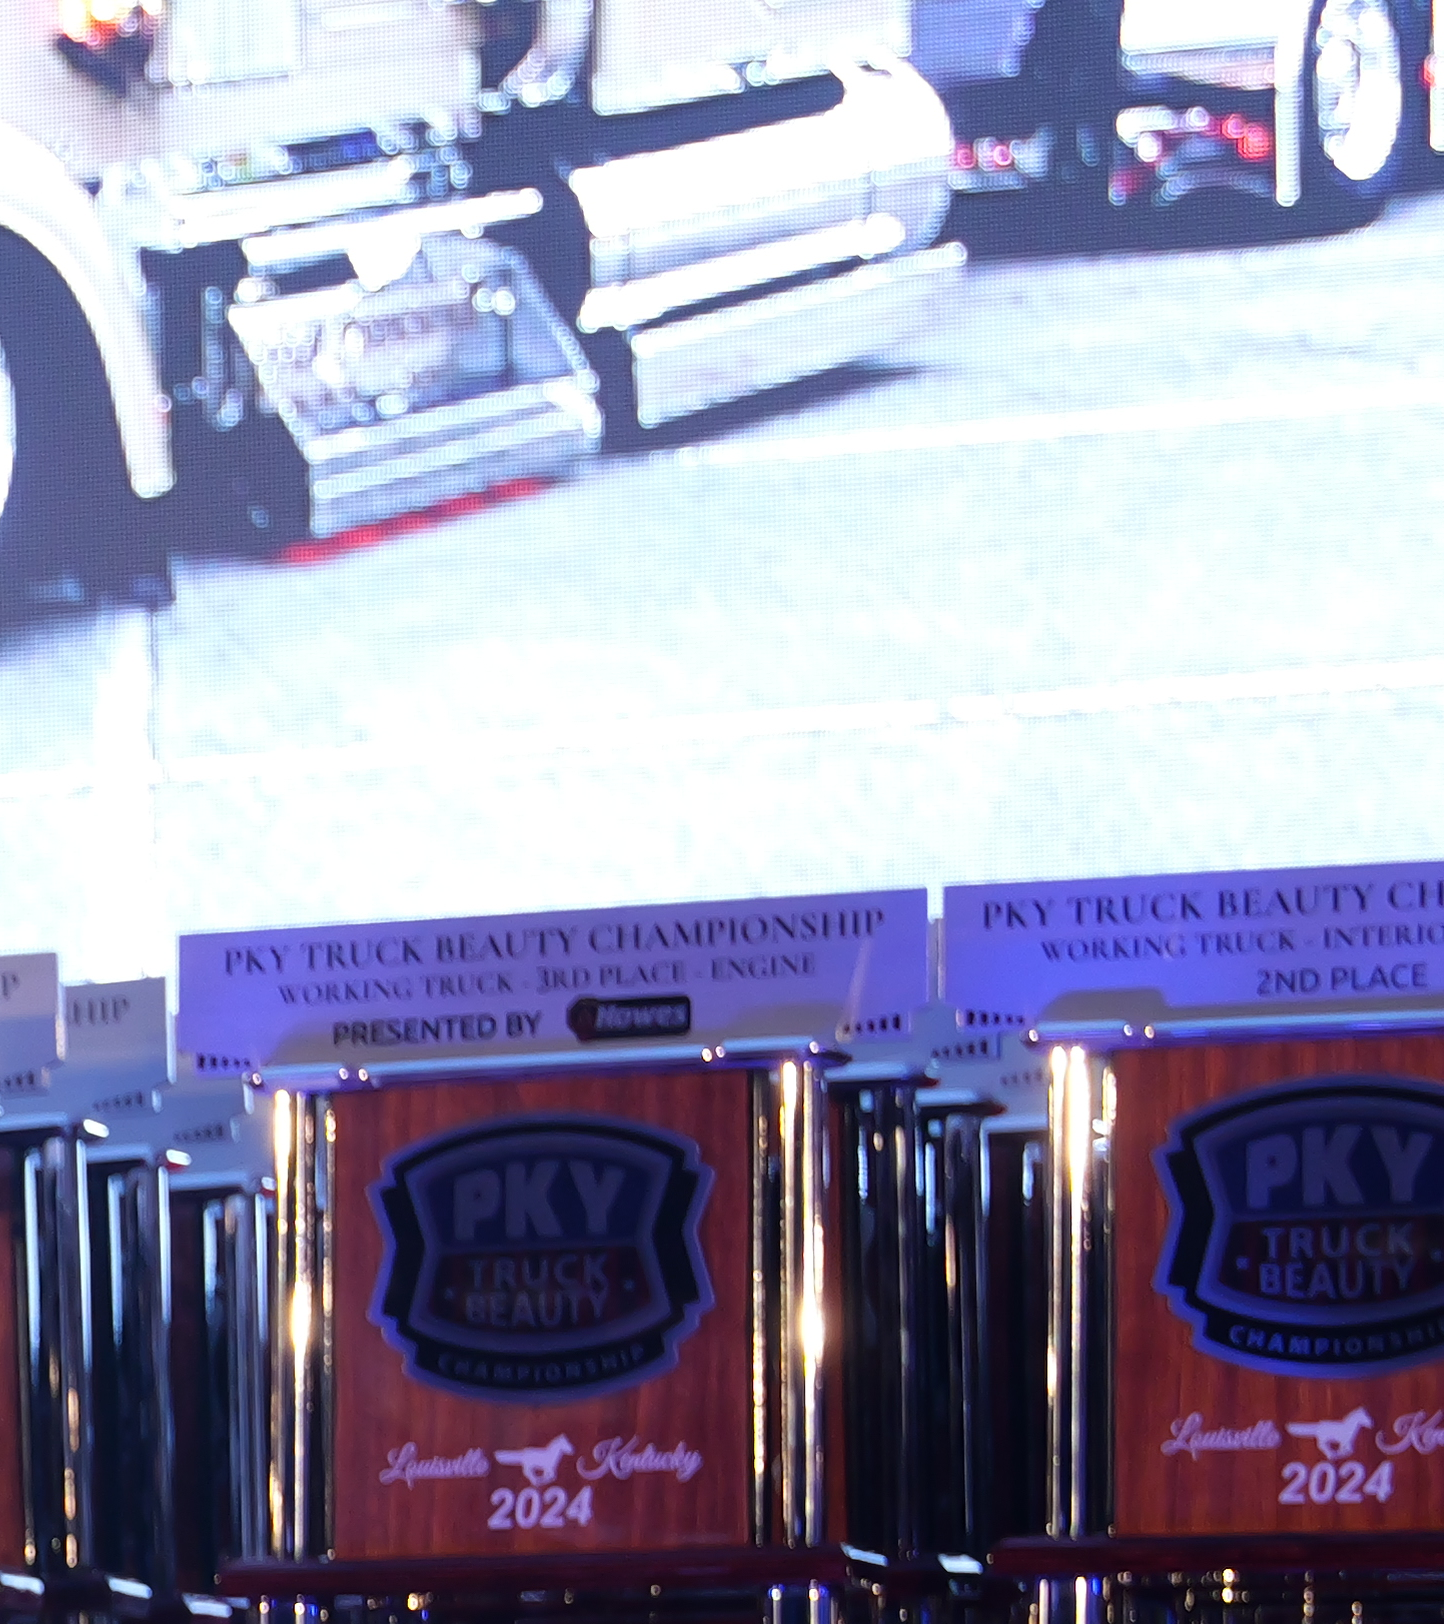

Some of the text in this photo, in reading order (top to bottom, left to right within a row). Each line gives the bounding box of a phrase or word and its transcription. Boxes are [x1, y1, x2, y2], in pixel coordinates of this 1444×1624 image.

[982, 898, 1055, 931] PKY
[1069, 890, 1204, 926] TRUCK
[1217, 881, 1376, 920] BEAUTY
[222, 907, 886, 978] PKY TRUCK BEAUTY CHAMPIONSHIP
[1040, 935, 1186, 963] WORKING
[1196, 929, 1297, 956] TRUCK
[277, 976, 414, 1006] WORKING
[421, 971, 514, 999] TRUCK
[536, 965, 593, 998] 3RD
[597, 958, 688, 988] PLACE
[709, 951, 816, 981] ENGINE
[1256, 962, 1429, 999] 2ND PLACE
[332, 1009, 542, 1047] PRESENTED BY
[1245, 1124, 1435, 1209] PKY
[453, 1159, 626, 1242] PKY
[1260, 1223, 1415, 1259] TRUCK
[468, 1254, 611, 1292] TRUCK
[1258, 1256, 1416, 1300] BEAUTY
[465, 1288, 608, 1329] BEAUTY
[1277, 1458, 1396, 1506] 2024
[486, 1485, 595, 1532] 2024
